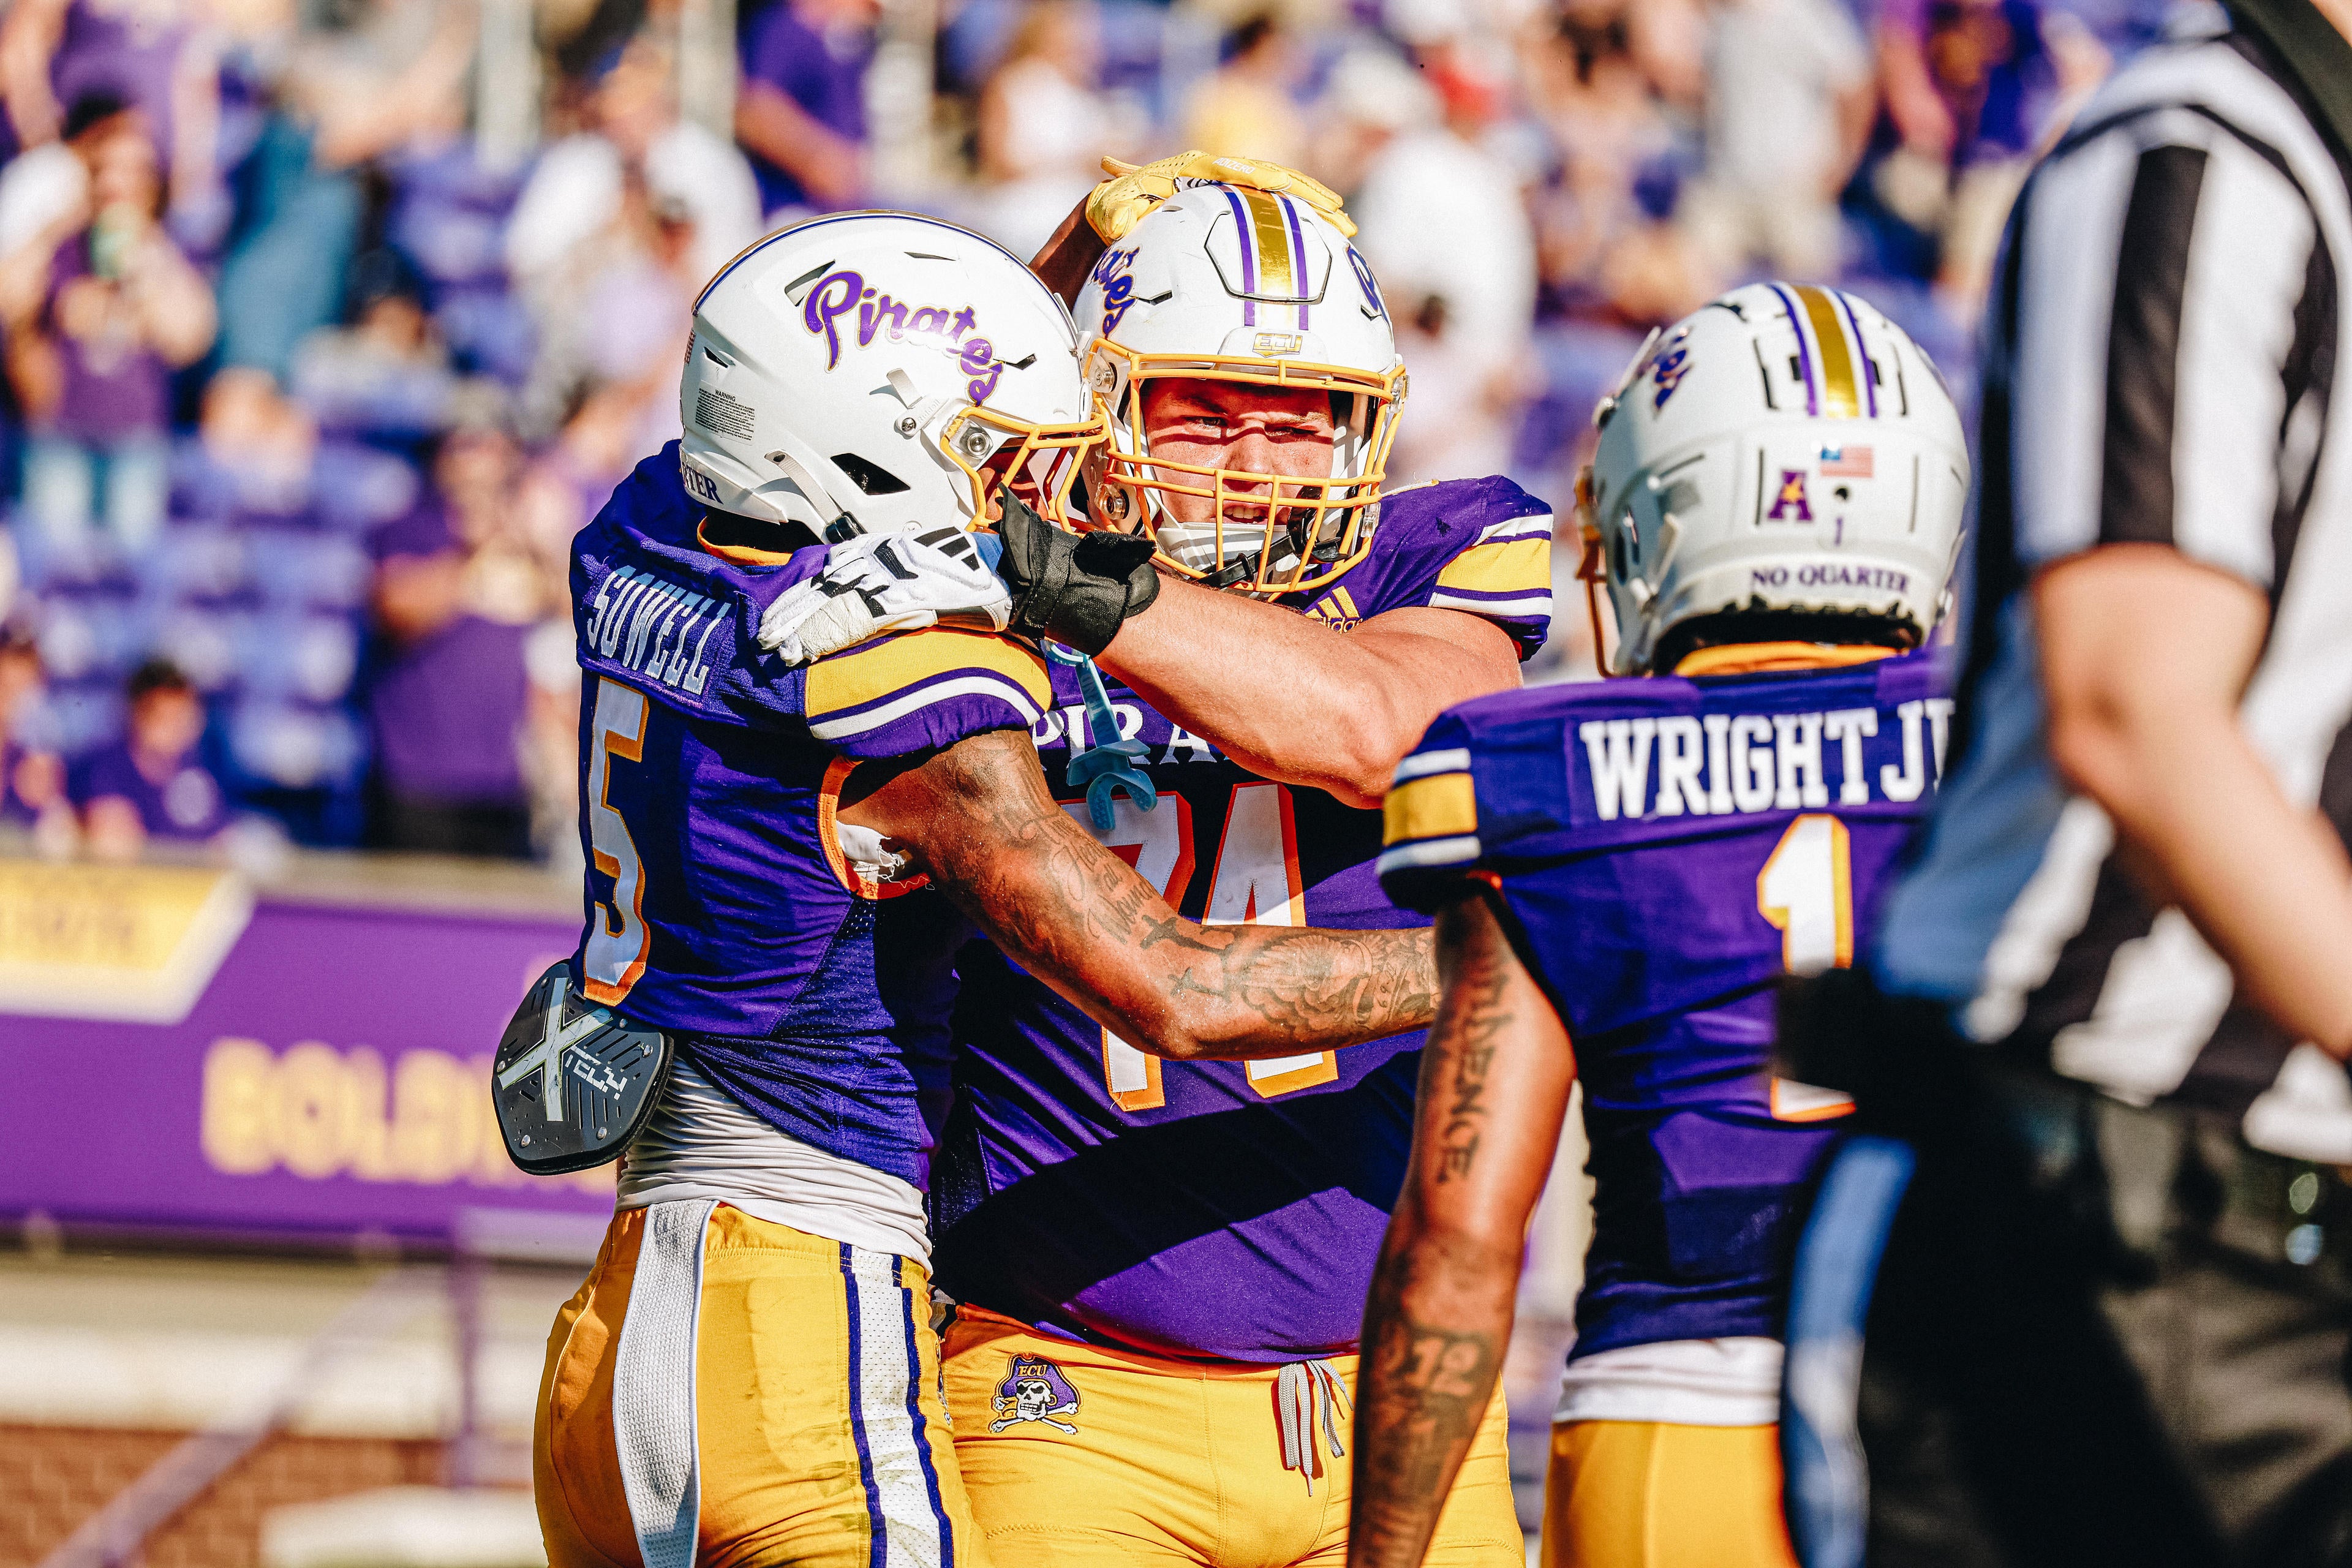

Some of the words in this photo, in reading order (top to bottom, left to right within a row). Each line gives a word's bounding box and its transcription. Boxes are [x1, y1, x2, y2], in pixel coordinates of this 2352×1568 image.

[1212, 157, 1256, 175] ADIZERO
[803, 270, 1004, 407] Pirates
[1253, 333, 1303, 352] ECU
[714, 389, 736, 402] WARNING
[1752, 567, 1790, 587] NO
[587, 565, 731, 695] SOWELL
[1032, 704, 1229, 771] PIRA
[1580, 707, 1879, 821] WRIGHT
[583, 676, 650, 1006] 5
[1756, 813, 1856, 1122] 1
[1017, 1365, 1048, 1377] ECU
